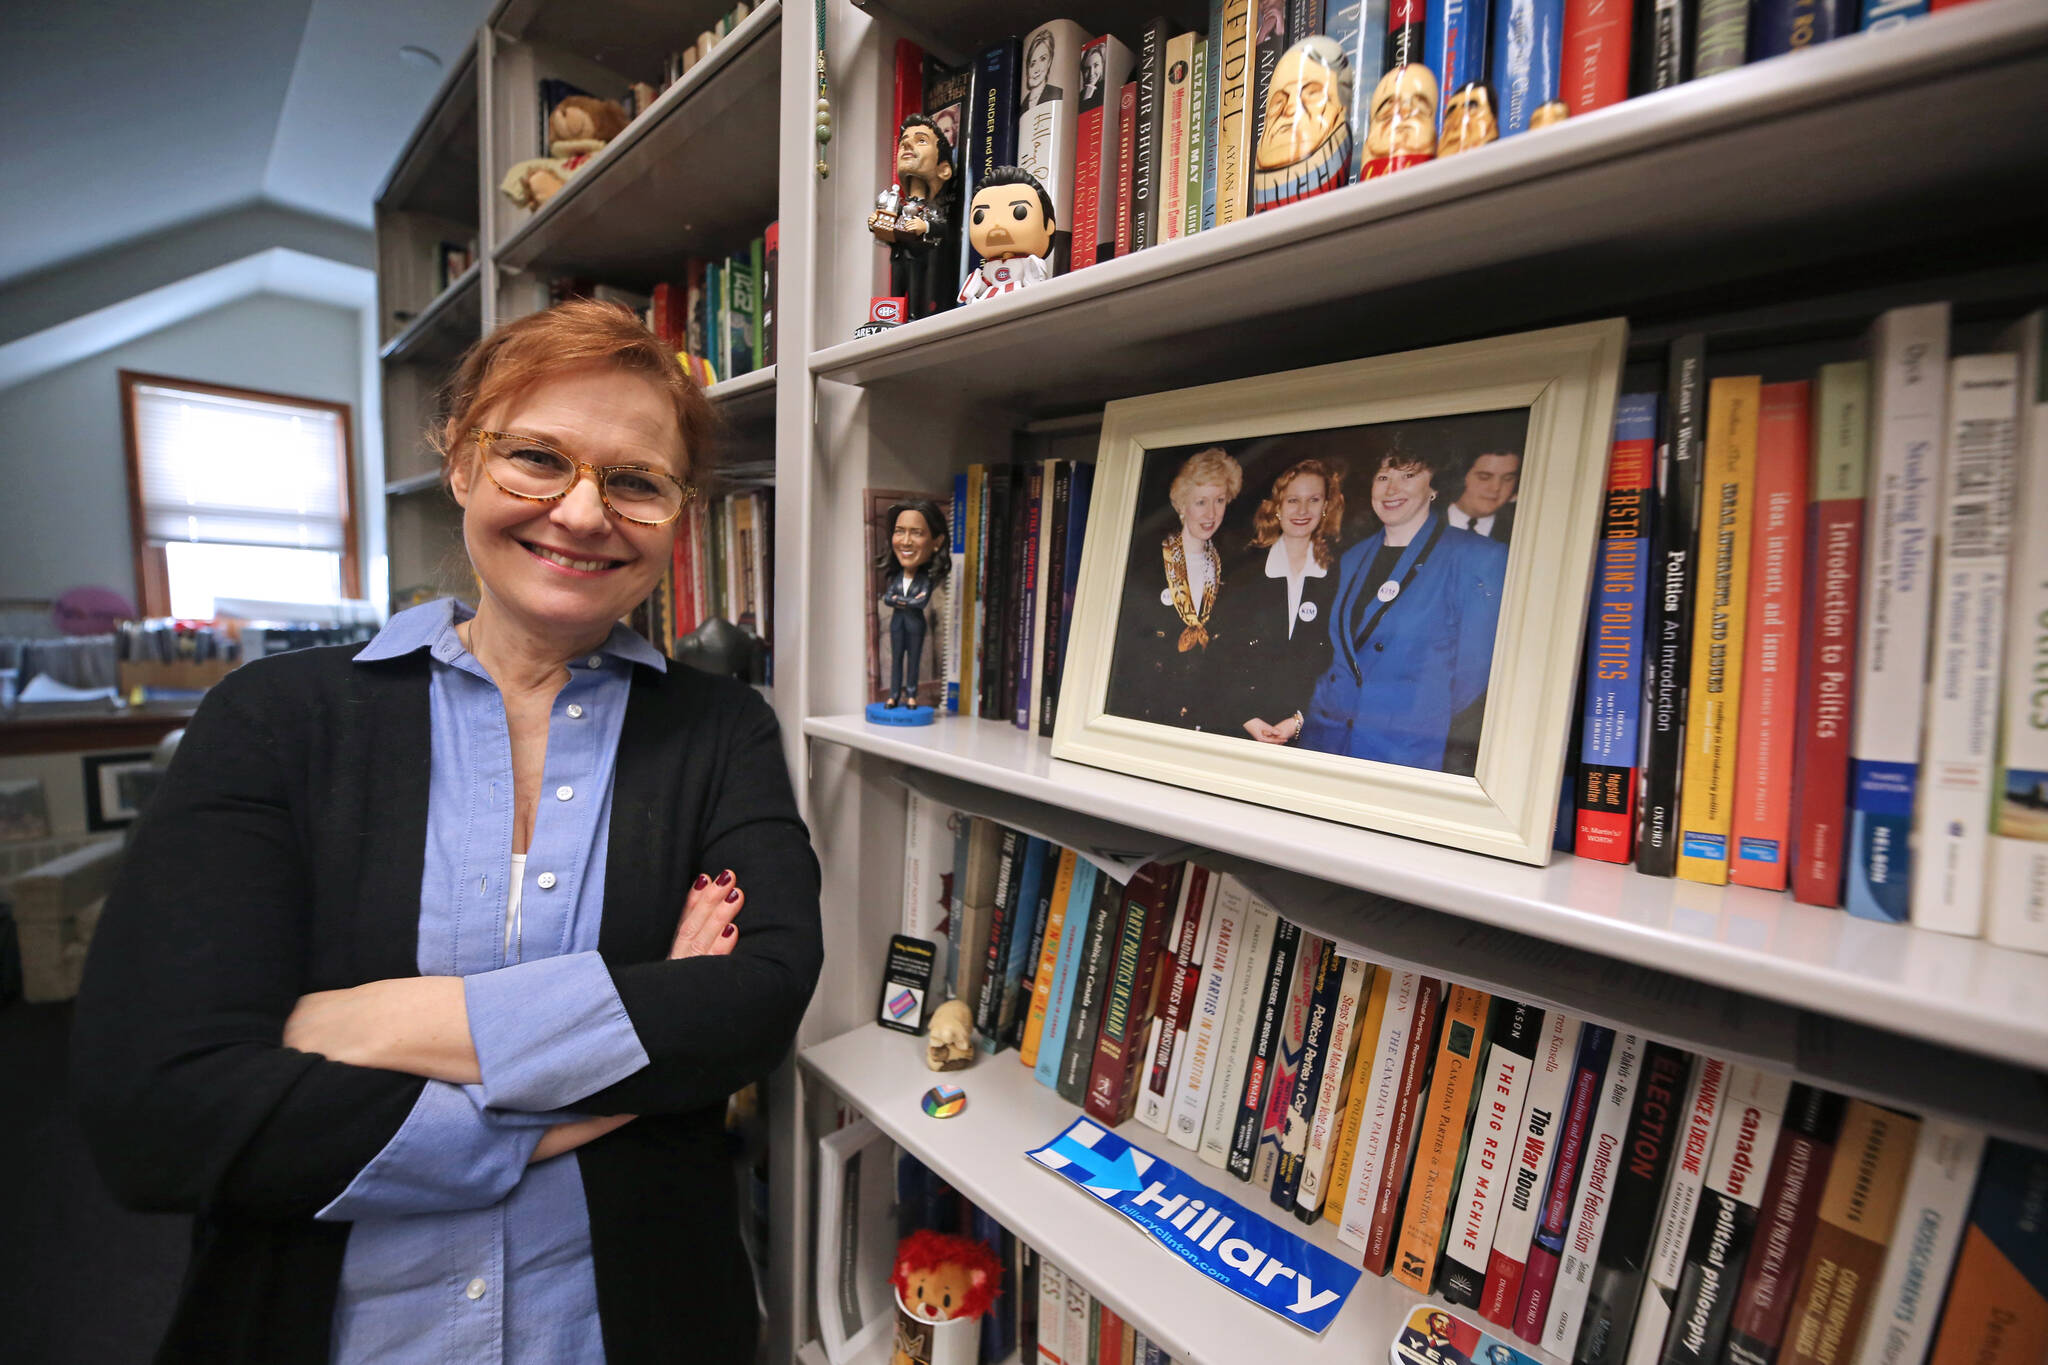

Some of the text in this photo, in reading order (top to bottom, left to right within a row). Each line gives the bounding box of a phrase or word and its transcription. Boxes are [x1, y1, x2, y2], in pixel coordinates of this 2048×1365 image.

[1581, 37, 1601, 107] TRUTH
[986, 88, 997, 145] GENDER and
[1509, 76, 1530, 130] Chance
[1135, 29, 1156, 251] BENAZIR BHUTTO RECON
[1186, 51, 1203, 234] ELIZABETH MAY LOSING
[1207, 116, 1219, 180] Warlords
[1084, 112, 1101, 252] HILLARY RODHAM
[1224, 143, 1237, 191] AYAAN
[1073, 160, 1087, 267] LIVING HISTO
[1118, 202, 1126, 249] INNOCENCE
[1676, 357, 1697, 461] MacLean Wood
[1029, 507, 1038, 533] STILL
[1603, 447, 1643, 593] UNDERSTANDING
[1025, 537, 1037, 589] COUNTING
[1760, 491, 1792, 673] ideas, interests, and issues
[1823, 521, 1855, 638] Introduction
[1896, 526, 1927, 593] Politics
[1301, 607, 1316, 617] KIM
[1598, 602, 1634, 681] POLITICS
[1656, 550, 1687, 732] Politics An Introduction
[1820, 646, 1842, 664] to
[1708, 643, 1727, 693] ISSUES
[1592, 696, 1603, 751] AND ISSUES
[1603, 692, 1616, 757] INSTITUTIONS,
[1816, 671, 1845, 739] Politics
[1587, 771, 1602, 804] Schotten
[1605, 772, 1622, 806] Magstadt
[1002, 831, 1017, 855] THE
[1587, 833, 1614, 845] WORTH
[1651, 805, 1665, 848] OXFORD
[1870, 825, 1892, 884] NELSON
[995, 857, 1013, 909] MORNING
[1035, 898, 1049, 934] Canadian
[1095, 909, 1108, 932] Party
[1125, 905, 1145, 940] PARTY
[1033, 912, 1064, 1022] WINNING POWER
[1088, 964, 1098, 974] in
[1089, 933, 1103, 964] Politics
[1117, 938, 1139, 986] POLITICS
[1212, 917, 1234, 973] CANADIAN
[1082, 975, 1096, 1007] Canada
[1115, 983, 1130, 999] IN
[1156, 919, 1196, 1068] CANADIAN PARTIES IN TRANSITION
[1203, 973, 1223, 1017] PARTIES
[1303, 955, 1312, 1008] CHALLENGE
[1420, 986, 1431, 1015] Political
[1107, 997, 1127, 1037] CANADA
[1200, 1017, 1213, 1031] IN
[1247, 950, 1286, 1107] PARTIES, LEADERS, AND IDEOLOGIES IN CANADA
[1293, 1004, 1303, 1045] CHANGE
[1415, 1015, 1426, 1042] Parties,
[1187, 1031, 1212, 1092] TRANSITION
[1298, 1003, 1326, 1092] Political Parties in
[1312, 994, 1355, 1150] Steps Toward Making Every Vote Count
[1359, 1060, 1370, 1085] Cross
[1403, 1043, 1420, 1097] Representation,
[1545, 1033, 1563, 1073] Kinsella
[1440, 1058, 1462, 1115] CANADIAN
[1574, 1072, 1593, 1121] Regionalism
[1611, 1050, 1635, 1107] Bakvis Baier
[1356, 1029, 1402, 1206] THE CANADIAN PARTY SYSTEM
[1394, 1113, 1407, 1143] Electoral
[1401, 1097, 1409, 1113] and
[1570, 1120, 1580, 1138] and
[1630, 1053, 1685, 1180] ELECTION
[1337, 1097, 1361, 1189] POLITICAL PARTIES
[1433, 1112, 1451, 1154] PARTIES
[1463, 1063, 1515, 1251] THE BIG RED MACHINE
[1564, 1137, 1578, 1160] Party
[1681, 1113, 1709, 1177] & DECLINE
[1387, 1143, 1400, 1182] Democracy
[1512, 1107, 1553, 1212] The War Room
[1558, 1160, 1573, 1190] Politics
[1381, 1188, 1392, 1215] Canada
[1418, 1167, 1440, 1226] TRANSITION
[1550, 1200, 1565, 1231] Canada
[1573, 1133, 1619, 1254] Contested Federalism
[1763, 1138, 1813, 1272] CONTEMPORARY POLITICAL
[1118, 1203, 1231, 1285] hillaryclinton.com
[1131, 1180, 1341, 1314] Hillary
[1373, 1225, 1385, 1256] OXFORD
[1682, 1106, 1762, 1357] canadian political philosophy
[1565, 1254, 1578, 1276] Edition
[1578, 1261, 1591, 1285] Second
[1492, 1277, 1508, 1315] DUNDURN
[1526, 1289, 1542, 1326] OXFORD
[1556, 1311, 1569, 1342] OXFORD
